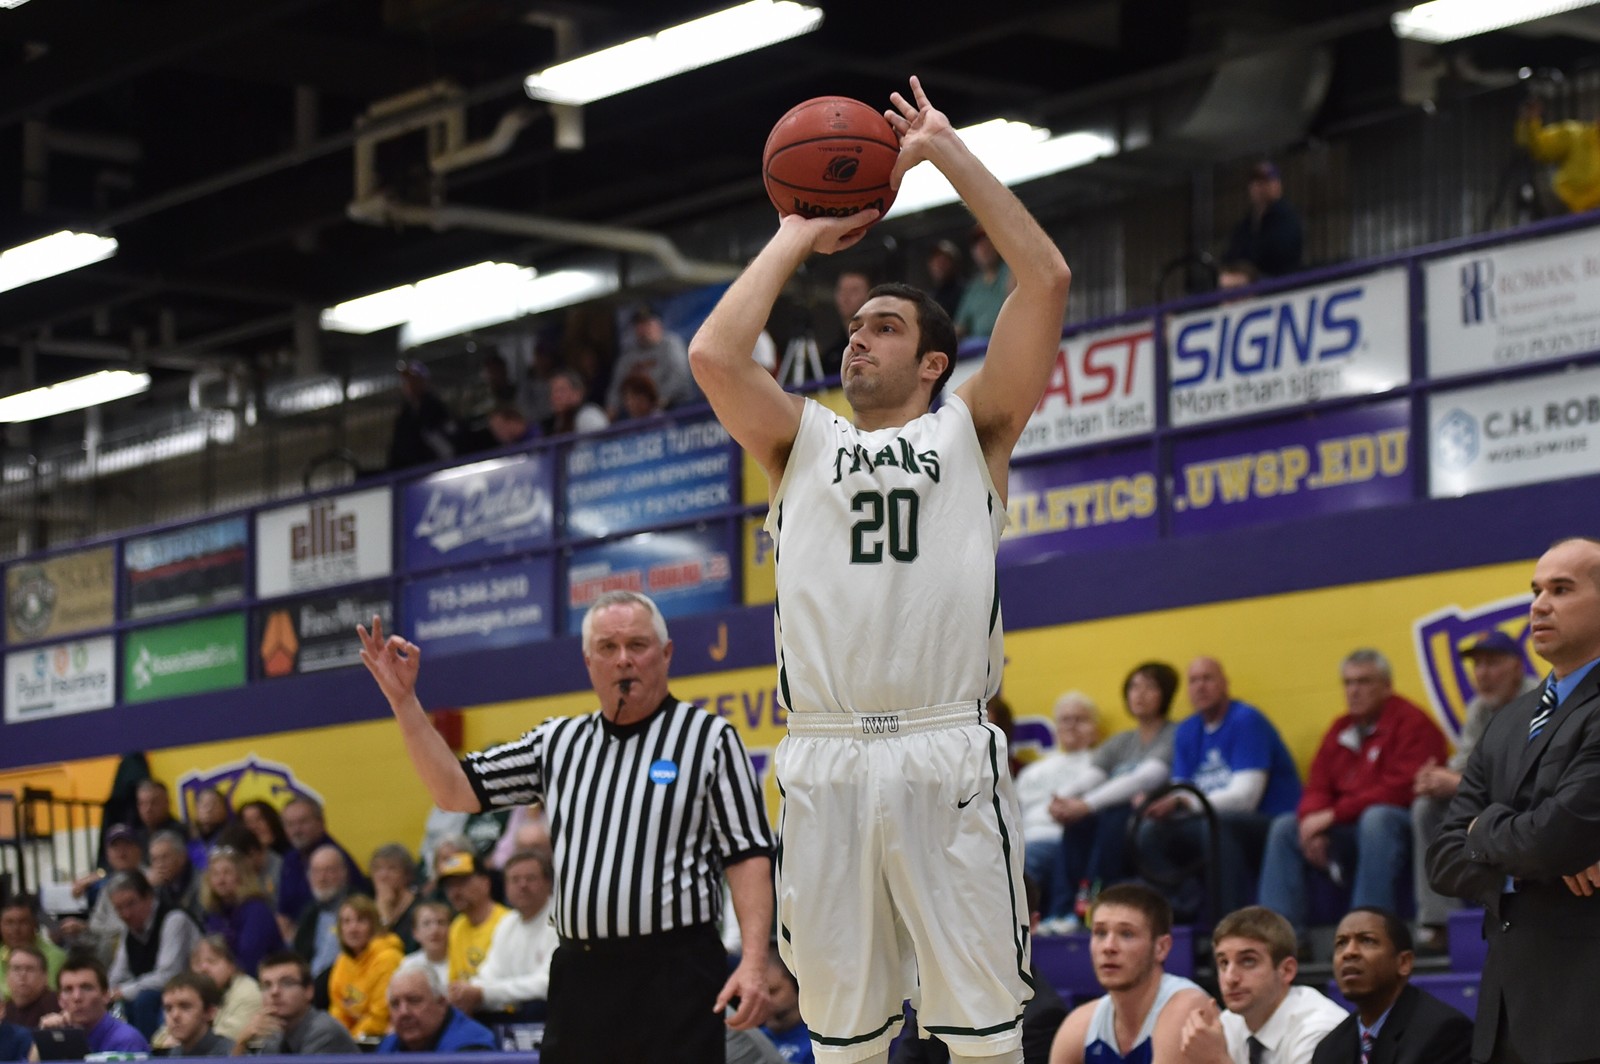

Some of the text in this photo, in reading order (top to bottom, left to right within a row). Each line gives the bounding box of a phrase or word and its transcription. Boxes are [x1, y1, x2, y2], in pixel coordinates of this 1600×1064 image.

[1172, 286, 1364, 388] SIGNS
[1037, 331, 1153, 412] AST
[1174, 390, 1229, 416] More
[1233, 378, 1285, 407] than
[1544, 394, 1600, 431] ROB
[1017, 425, 1048, 447] ore
[1054, 412, 1099, 435] than
[832, 436, 941, 485] TITANS
[290, 498, 357, 561] ellis
[849, 487, 920, 565] 20
[861, 715, 900, 734] IWU
